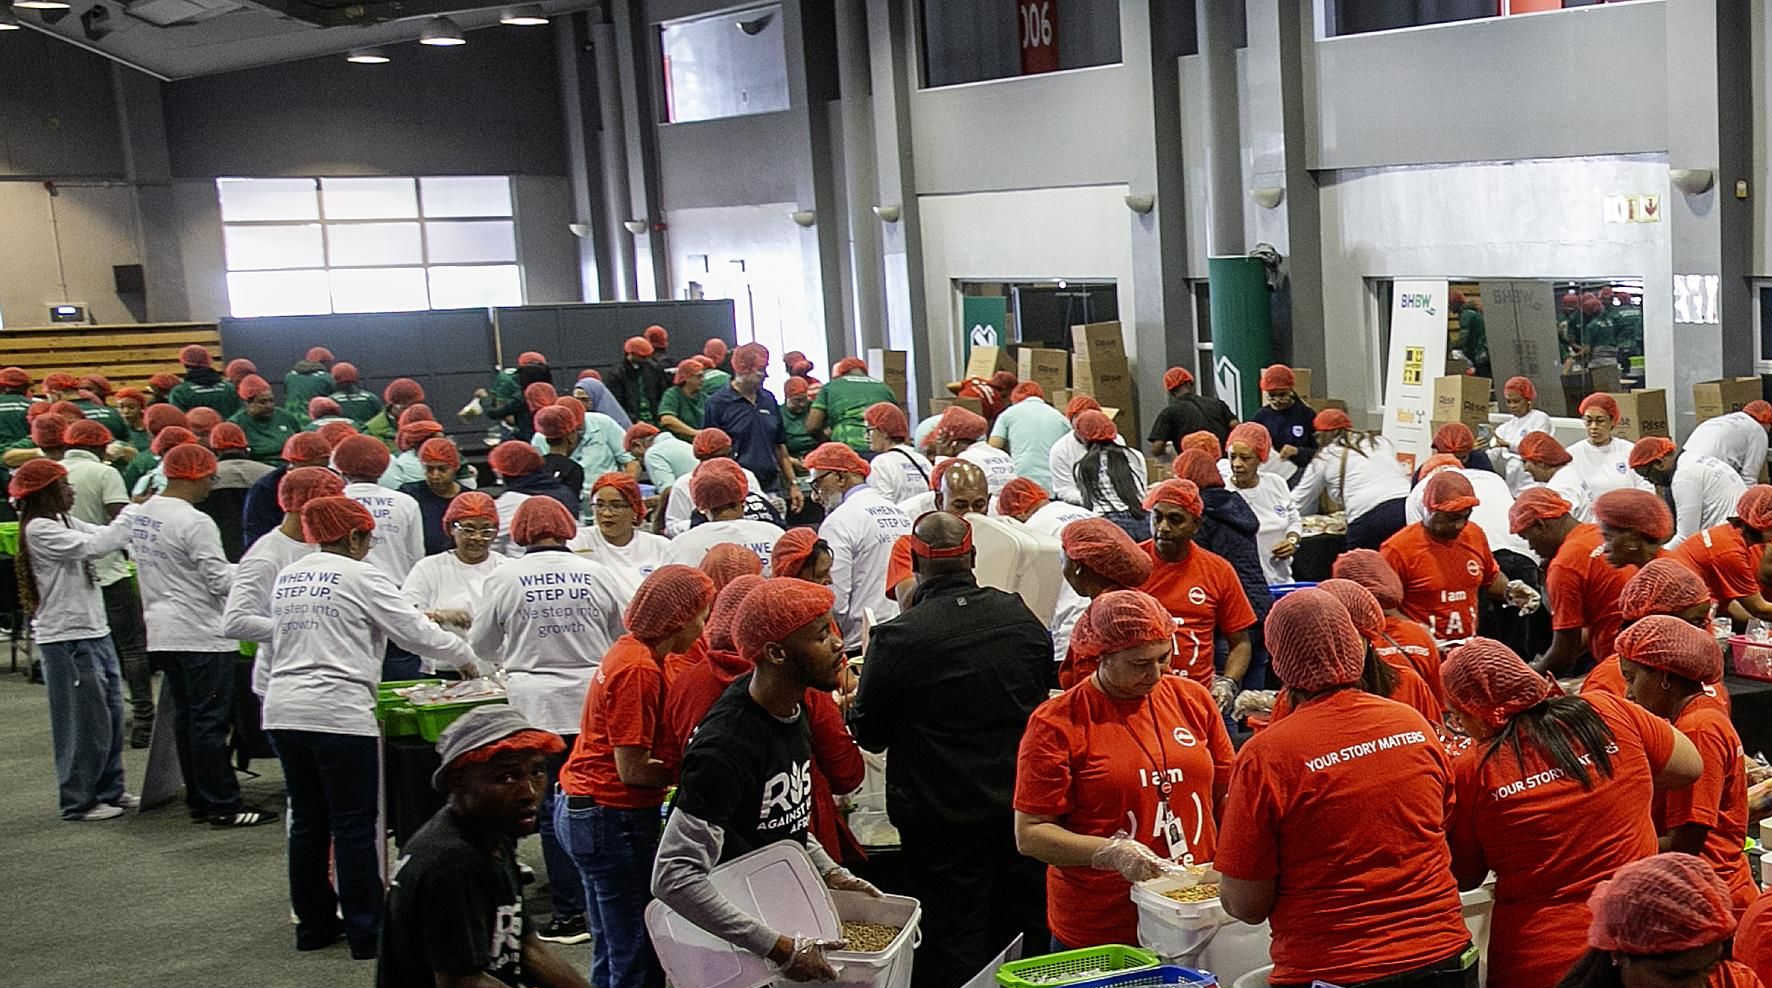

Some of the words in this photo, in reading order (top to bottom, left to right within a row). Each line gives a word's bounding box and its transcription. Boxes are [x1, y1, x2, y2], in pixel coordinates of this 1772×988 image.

[279, 572, 315, 585] WHEN
[319, 573, 342, 585] WE
[519, 573, 566, 587] WHEN
[570, 573, 592, 586] WE
[276, 586, 307, 600] STEP
[310, 586, 332, 600] UP.
[525, 589, 565, 602] STEP
[1441, 590, 1447, 603] I
[1448, 590, 1467, 602] am
[313, 604, 340, 618] into
[519, 607, 539, 620] We
[543, 605, 573, 620] step
[538, 622, 586, 638] growth
[1305, 752, 1341, 772] YOUR
[1340, 741, 1377, 761] STORY
[1378, 731, 1426, 751] MATTERS
[1491, 780, 1526, 801] YOUR
[1526, 767, 1566, 789] STORY
[757, 803, 805, 830] AGAINST
